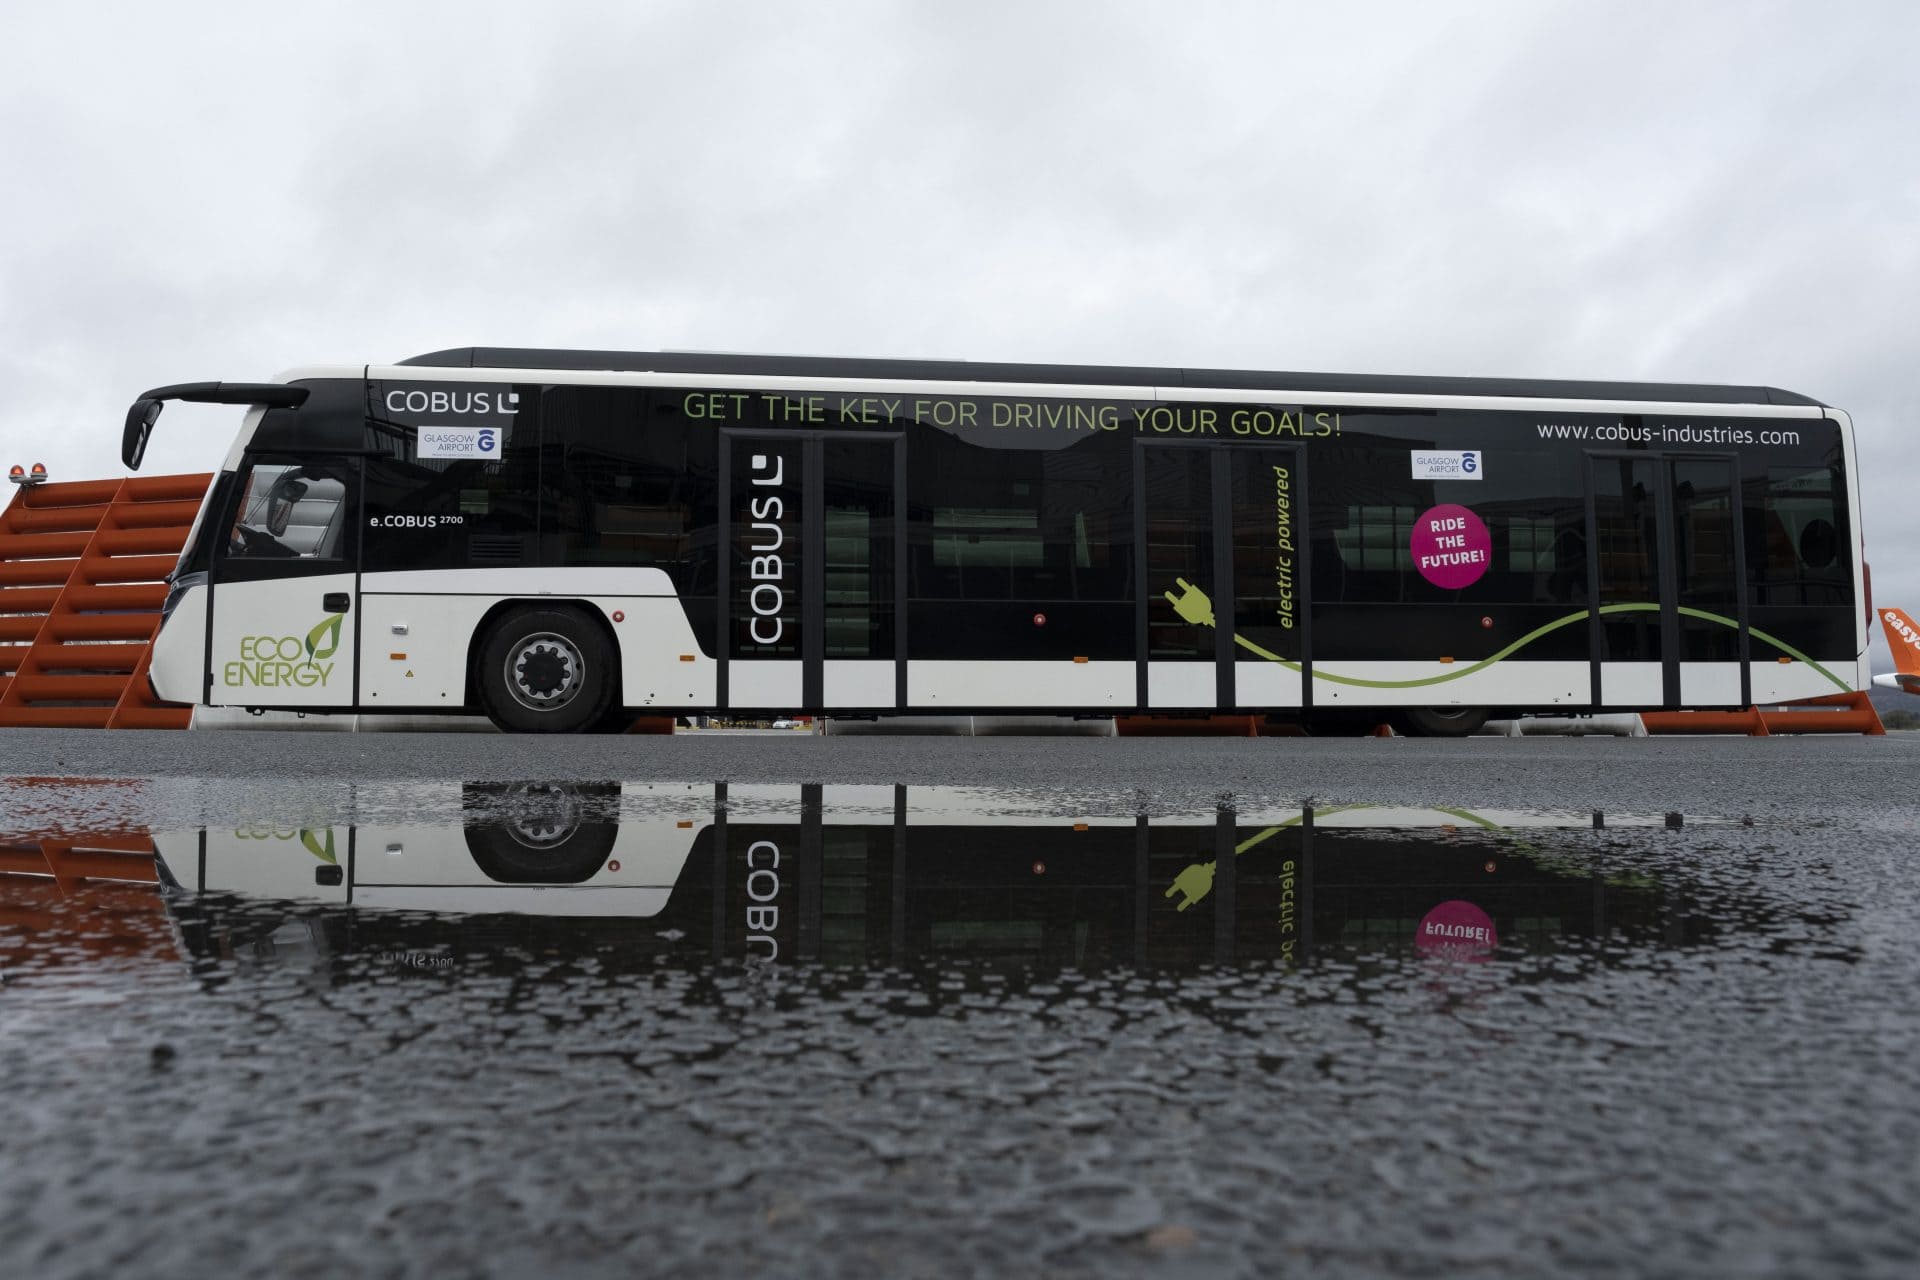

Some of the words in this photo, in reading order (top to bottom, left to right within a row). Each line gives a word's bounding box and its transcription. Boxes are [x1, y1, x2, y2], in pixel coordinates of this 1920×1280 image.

[386, 390, 490, 413] COBUS
[684, 393, 749, 419] GET
[761, 395, 825, 421] THE
[840, 398, 901, 424] KEY
[915, 400, 978, 426] FOR
[992, 403, 1119, 431] DRIVING
[1132, 407, 1218, 434] YOUR
[1231, 410, 1342, 437] GOALS!
[424, 434, 475, 443] GLASGOW
[1537, 423, 1800, 445] www.cobus-industries.com
[437, 443, 474, 452] AIRPORT
[1416, 457, 1459, 465] GLASGOW
[1428, 465, 1459, 473] AIRPORT
[1272, 465, 1294, 552] powered
[370, 515, 437, 528] e.COBUS
[439, 516, 464, 524] 2700
[1430, 517, 1466, 532] RIDE
[1435, 535, 1466, 549] THE
[1421, 549, 1485, 569] FUTURE!
[750, 496, 783, 645] COBUS
[1276, 556, 1293, 629] electric
[1884, 611, 1920, 650] easy
[240, 636, 303, 661] ECO
[224, 661, 334, 687] ENERGY
